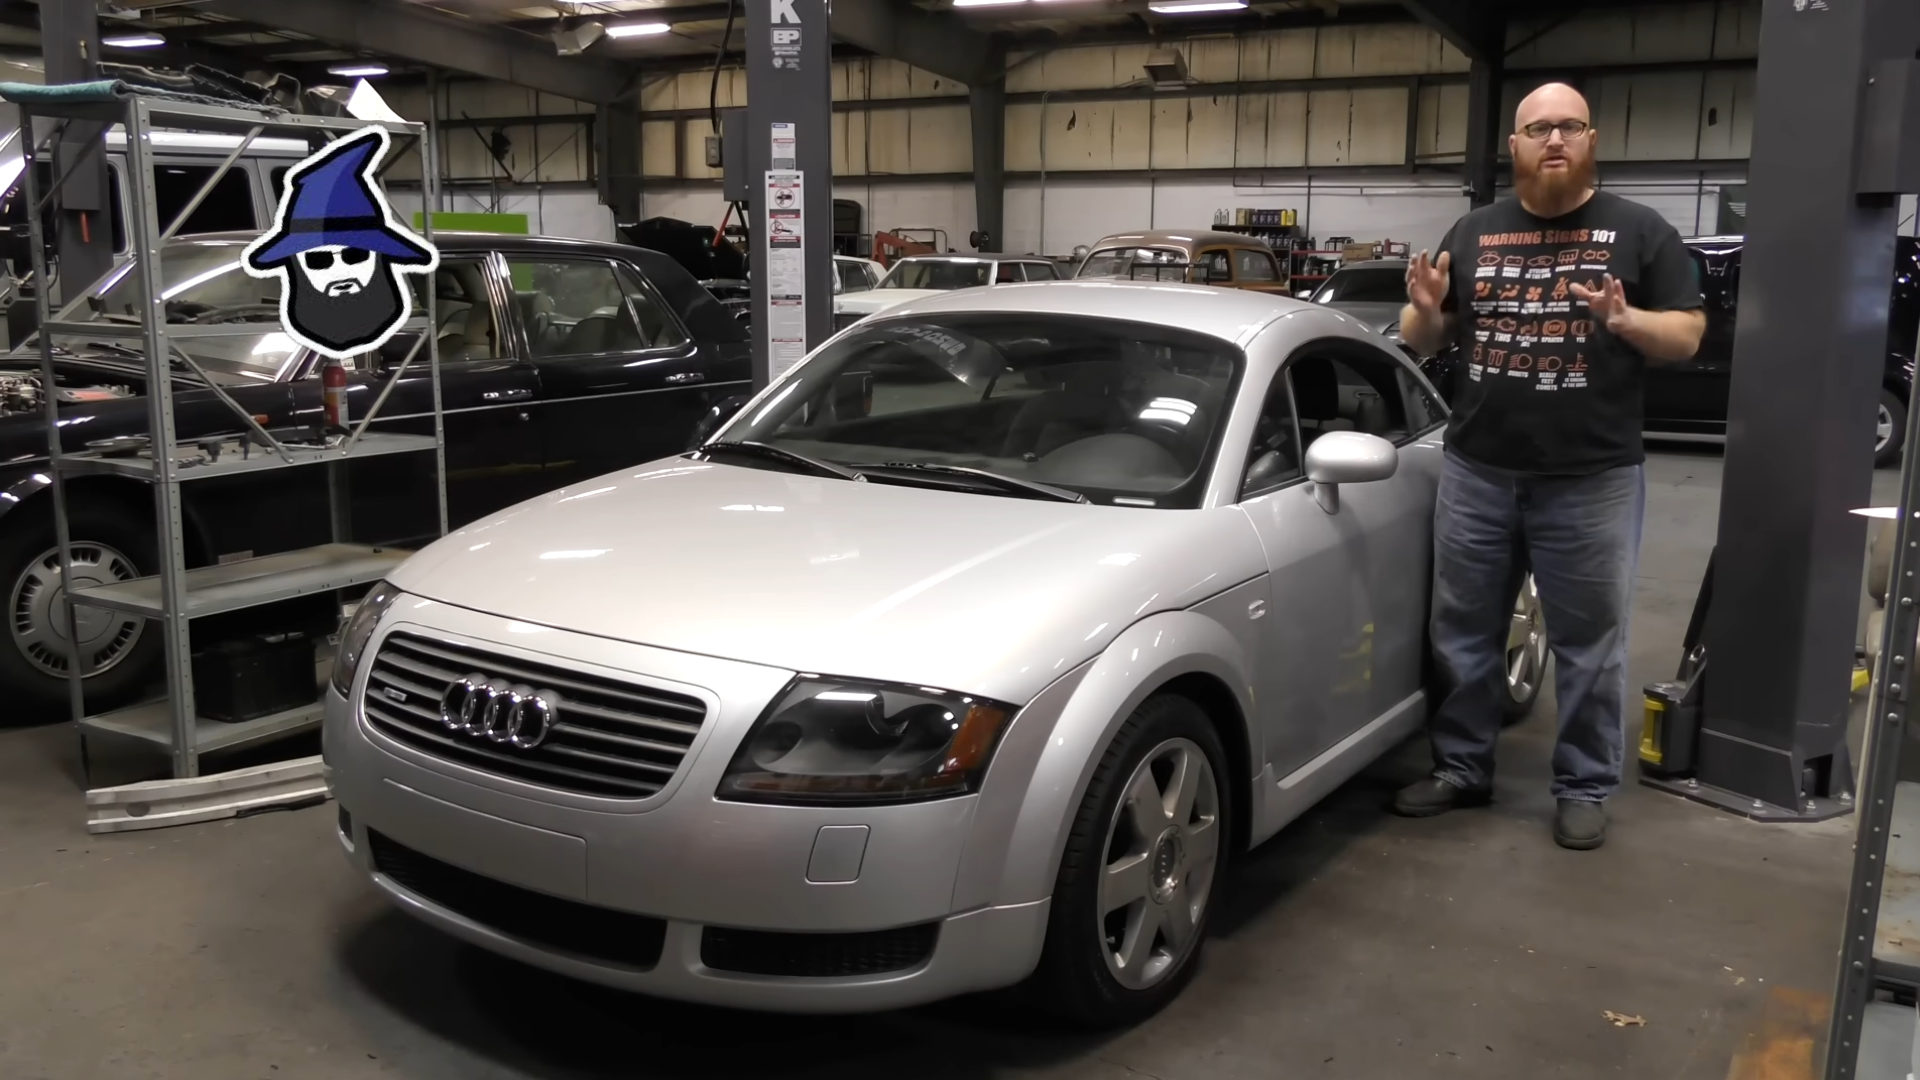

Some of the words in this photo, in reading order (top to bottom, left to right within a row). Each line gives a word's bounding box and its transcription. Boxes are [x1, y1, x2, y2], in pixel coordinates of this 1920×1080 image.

[1479, 231, 1542, 247] WARNING
[1544, 229, 1589, 244] SIGNS
[1591, 229, 1616, 243] 101
[1494, 332, 1512, 343] THIS
